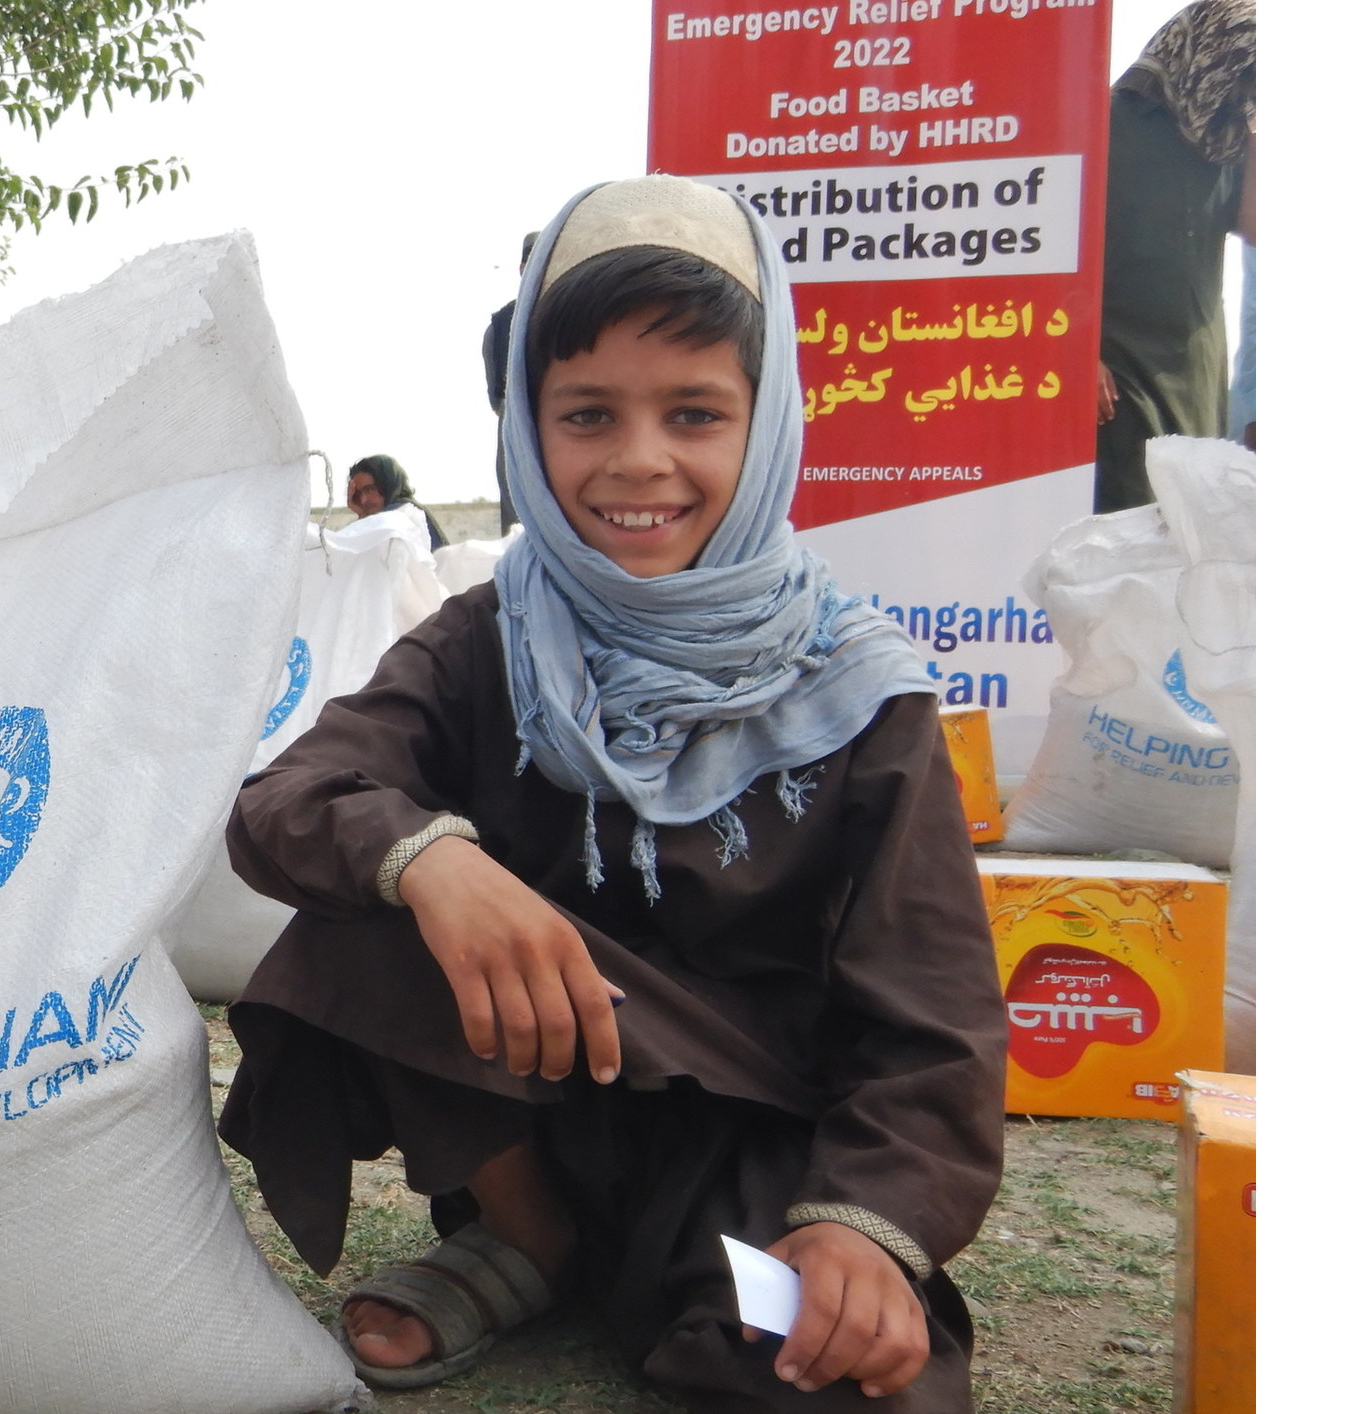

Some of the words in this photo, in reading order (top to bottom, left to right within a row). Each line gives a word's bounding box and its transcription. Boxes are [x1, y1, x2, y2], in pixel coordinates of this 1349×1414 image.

[667, 3, 838, 41] Emergency
[849, 0, 942, 25] Relief
[833, 37, 911, 68] 2022
[770, 89, 847, 119] Food
[858, 81, 974, 113] Basket
[726, 126, 858, 158] Donated
[869, 125, 908, 156] by
[918, 115, 1019, 148] HHRD
[718, 175, 979, 217] stribution
[993, 167, 1045, 206] of
[823, 222, 1042, 266] Packages
[858, 299, 1033, 353] افغانستان
[1046, 308, 1069, 336] د
[1037, 370, 1061, 399] د
[803, 466, 904, 481] EMERGENCY
[909, 465, 982, 481] APPEALS
[872, 594, 1053, 653] angarha
[1088, 704, 1231, 770] HELPING
[1134, 1083, 1180, 1099] ABIB
